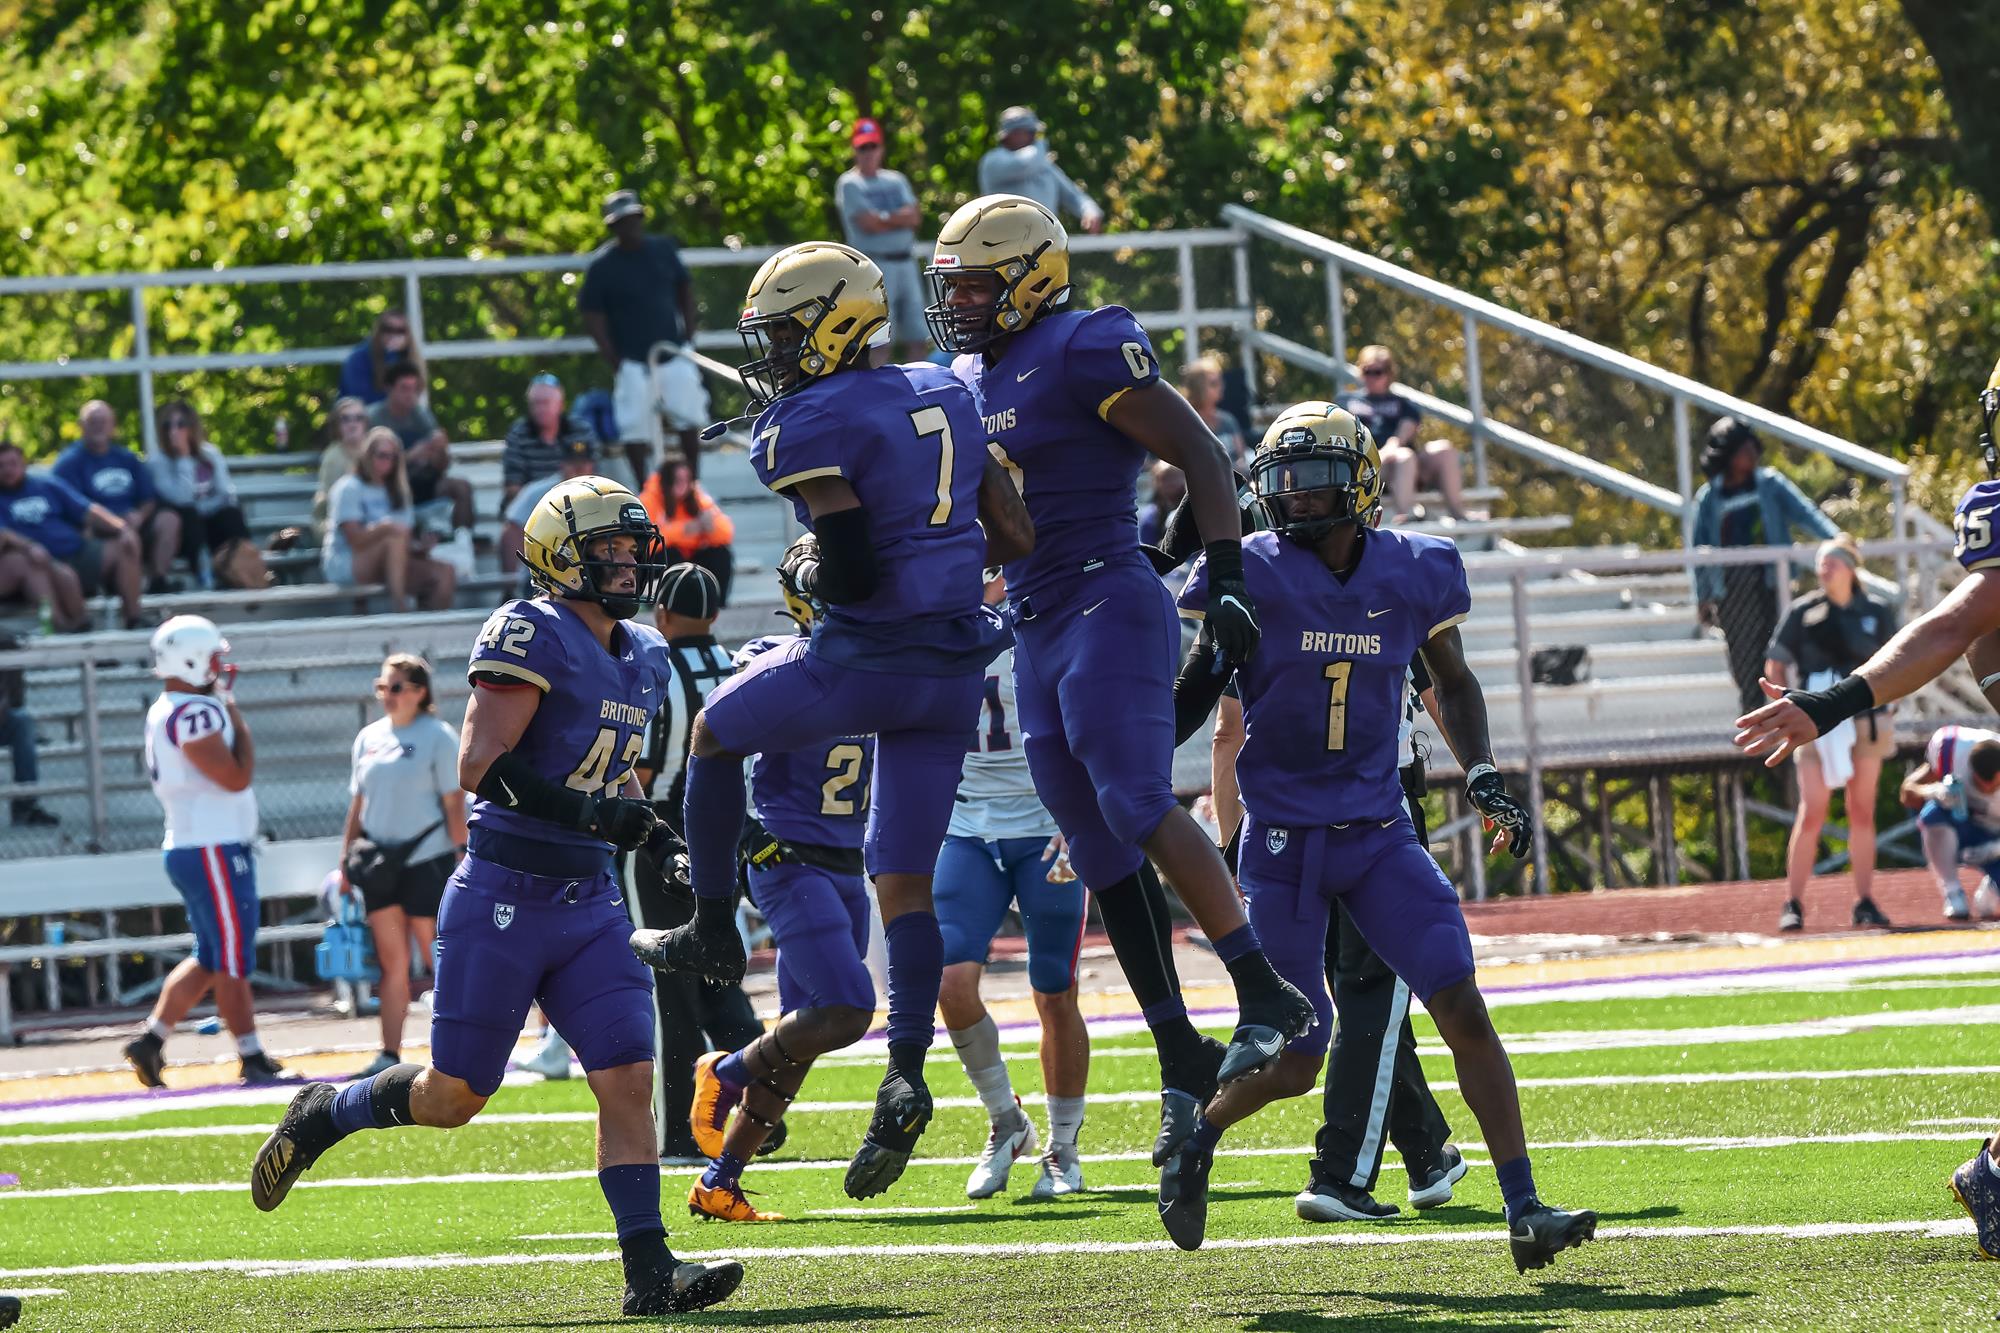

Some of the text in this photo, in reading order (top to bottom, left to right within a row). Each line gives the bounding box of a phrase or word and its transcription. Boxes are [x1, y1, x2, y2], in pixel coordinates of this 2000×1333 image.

[760, 424, 781, 472] 7
[981, 407, 1017, 435] TONS
[909, 405, 955, 526] 7
[479, 615, 537, 659] 42
[1301, 631, 1381, 655] BRITONS
[600, 699, 647, 727] BRITONS
[966, 675, 1012, 753] 1
[1324, 661, 1352, 750] 1
[564, 727, 644, 799] 42
[820, 744, 874, 816] 2
